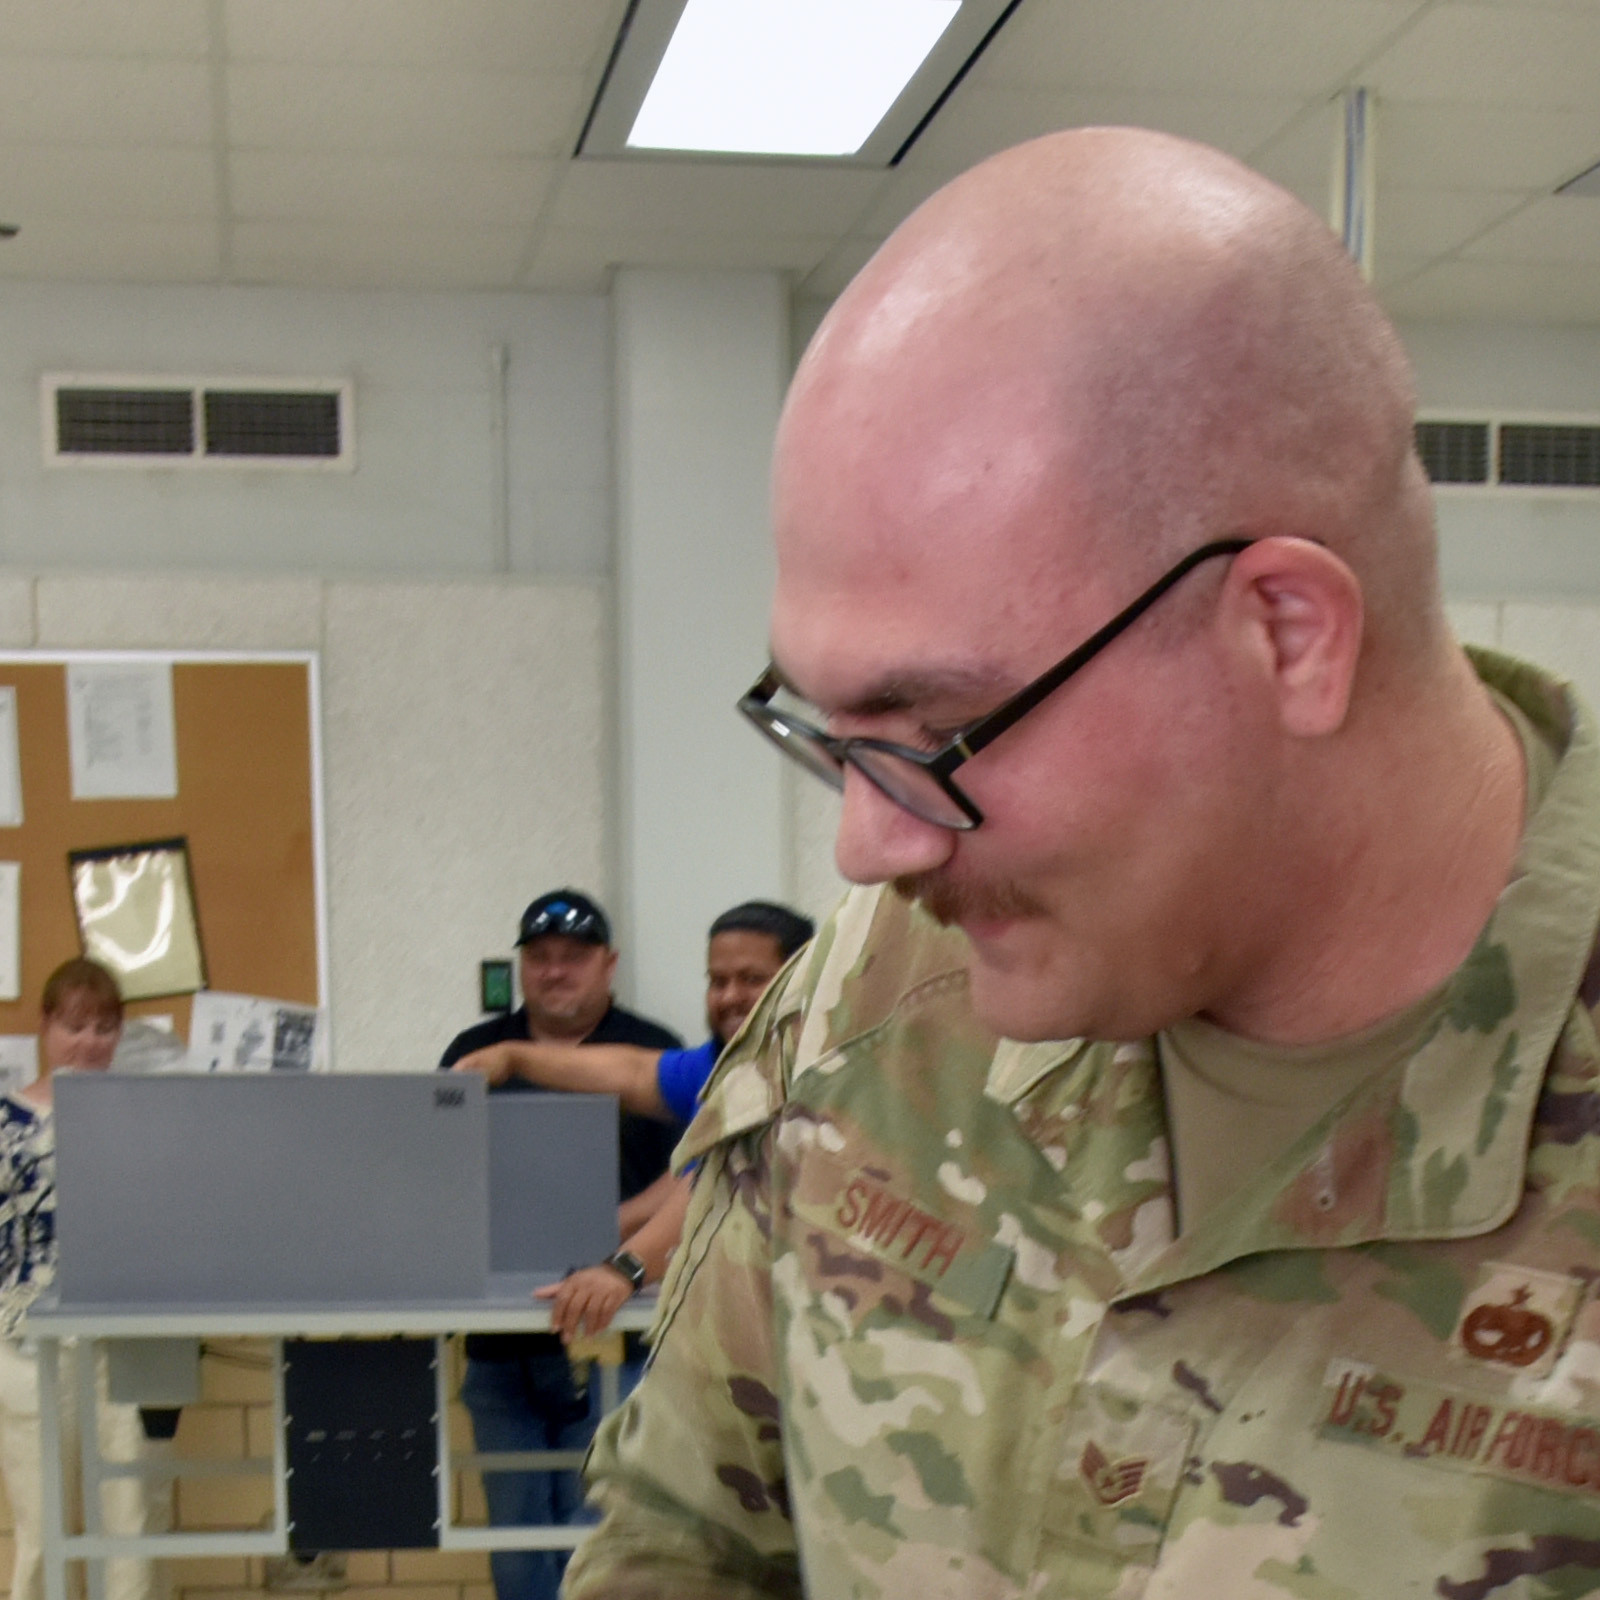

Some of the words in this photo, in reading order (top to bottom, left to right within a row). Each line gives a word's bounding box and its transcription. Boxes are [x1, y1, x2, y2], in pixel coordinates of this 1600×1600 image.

[837, 1177, 967, 1278] SMITH
[1328, 1370, 1405, 1443] U.S.
[1418, 1398, 1494, 1460] AIR
